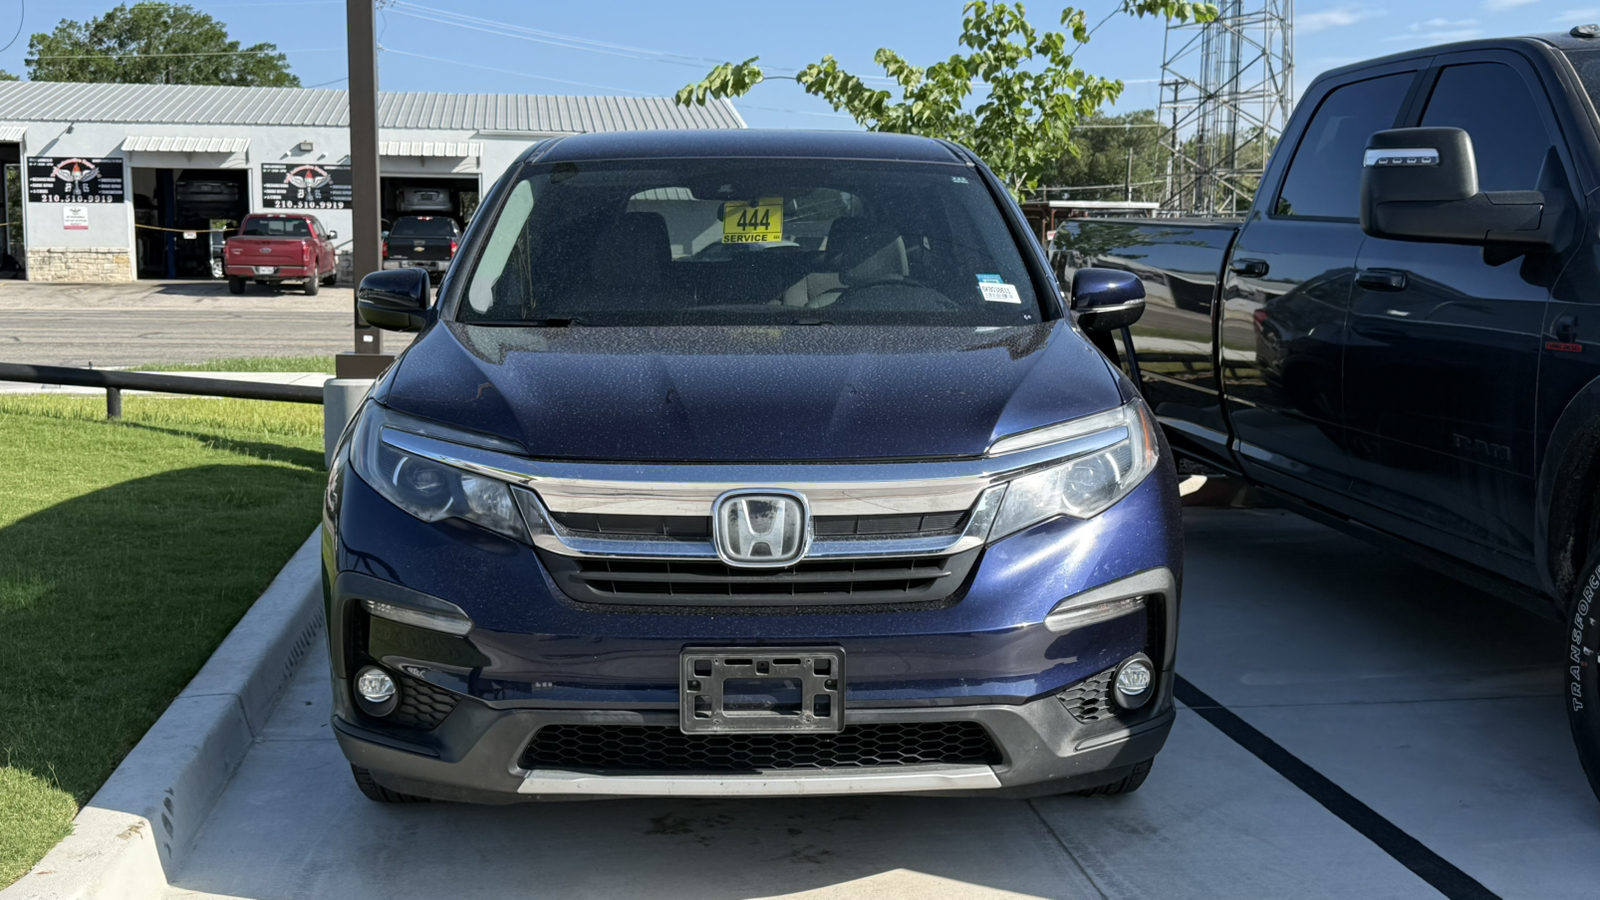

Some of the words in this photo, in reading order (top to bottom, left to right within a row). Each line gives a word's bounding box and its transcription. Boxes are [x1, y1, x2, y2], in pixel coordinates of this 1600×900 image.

[41, 194, 113, 203] 210.510.9919
[274, 200, 344, 209] 210.510.9919
[737, 208, 771, 231] 444
[723, 234, 768, 243] SERVICE
[1452, 433, 1511, 461] RAM
